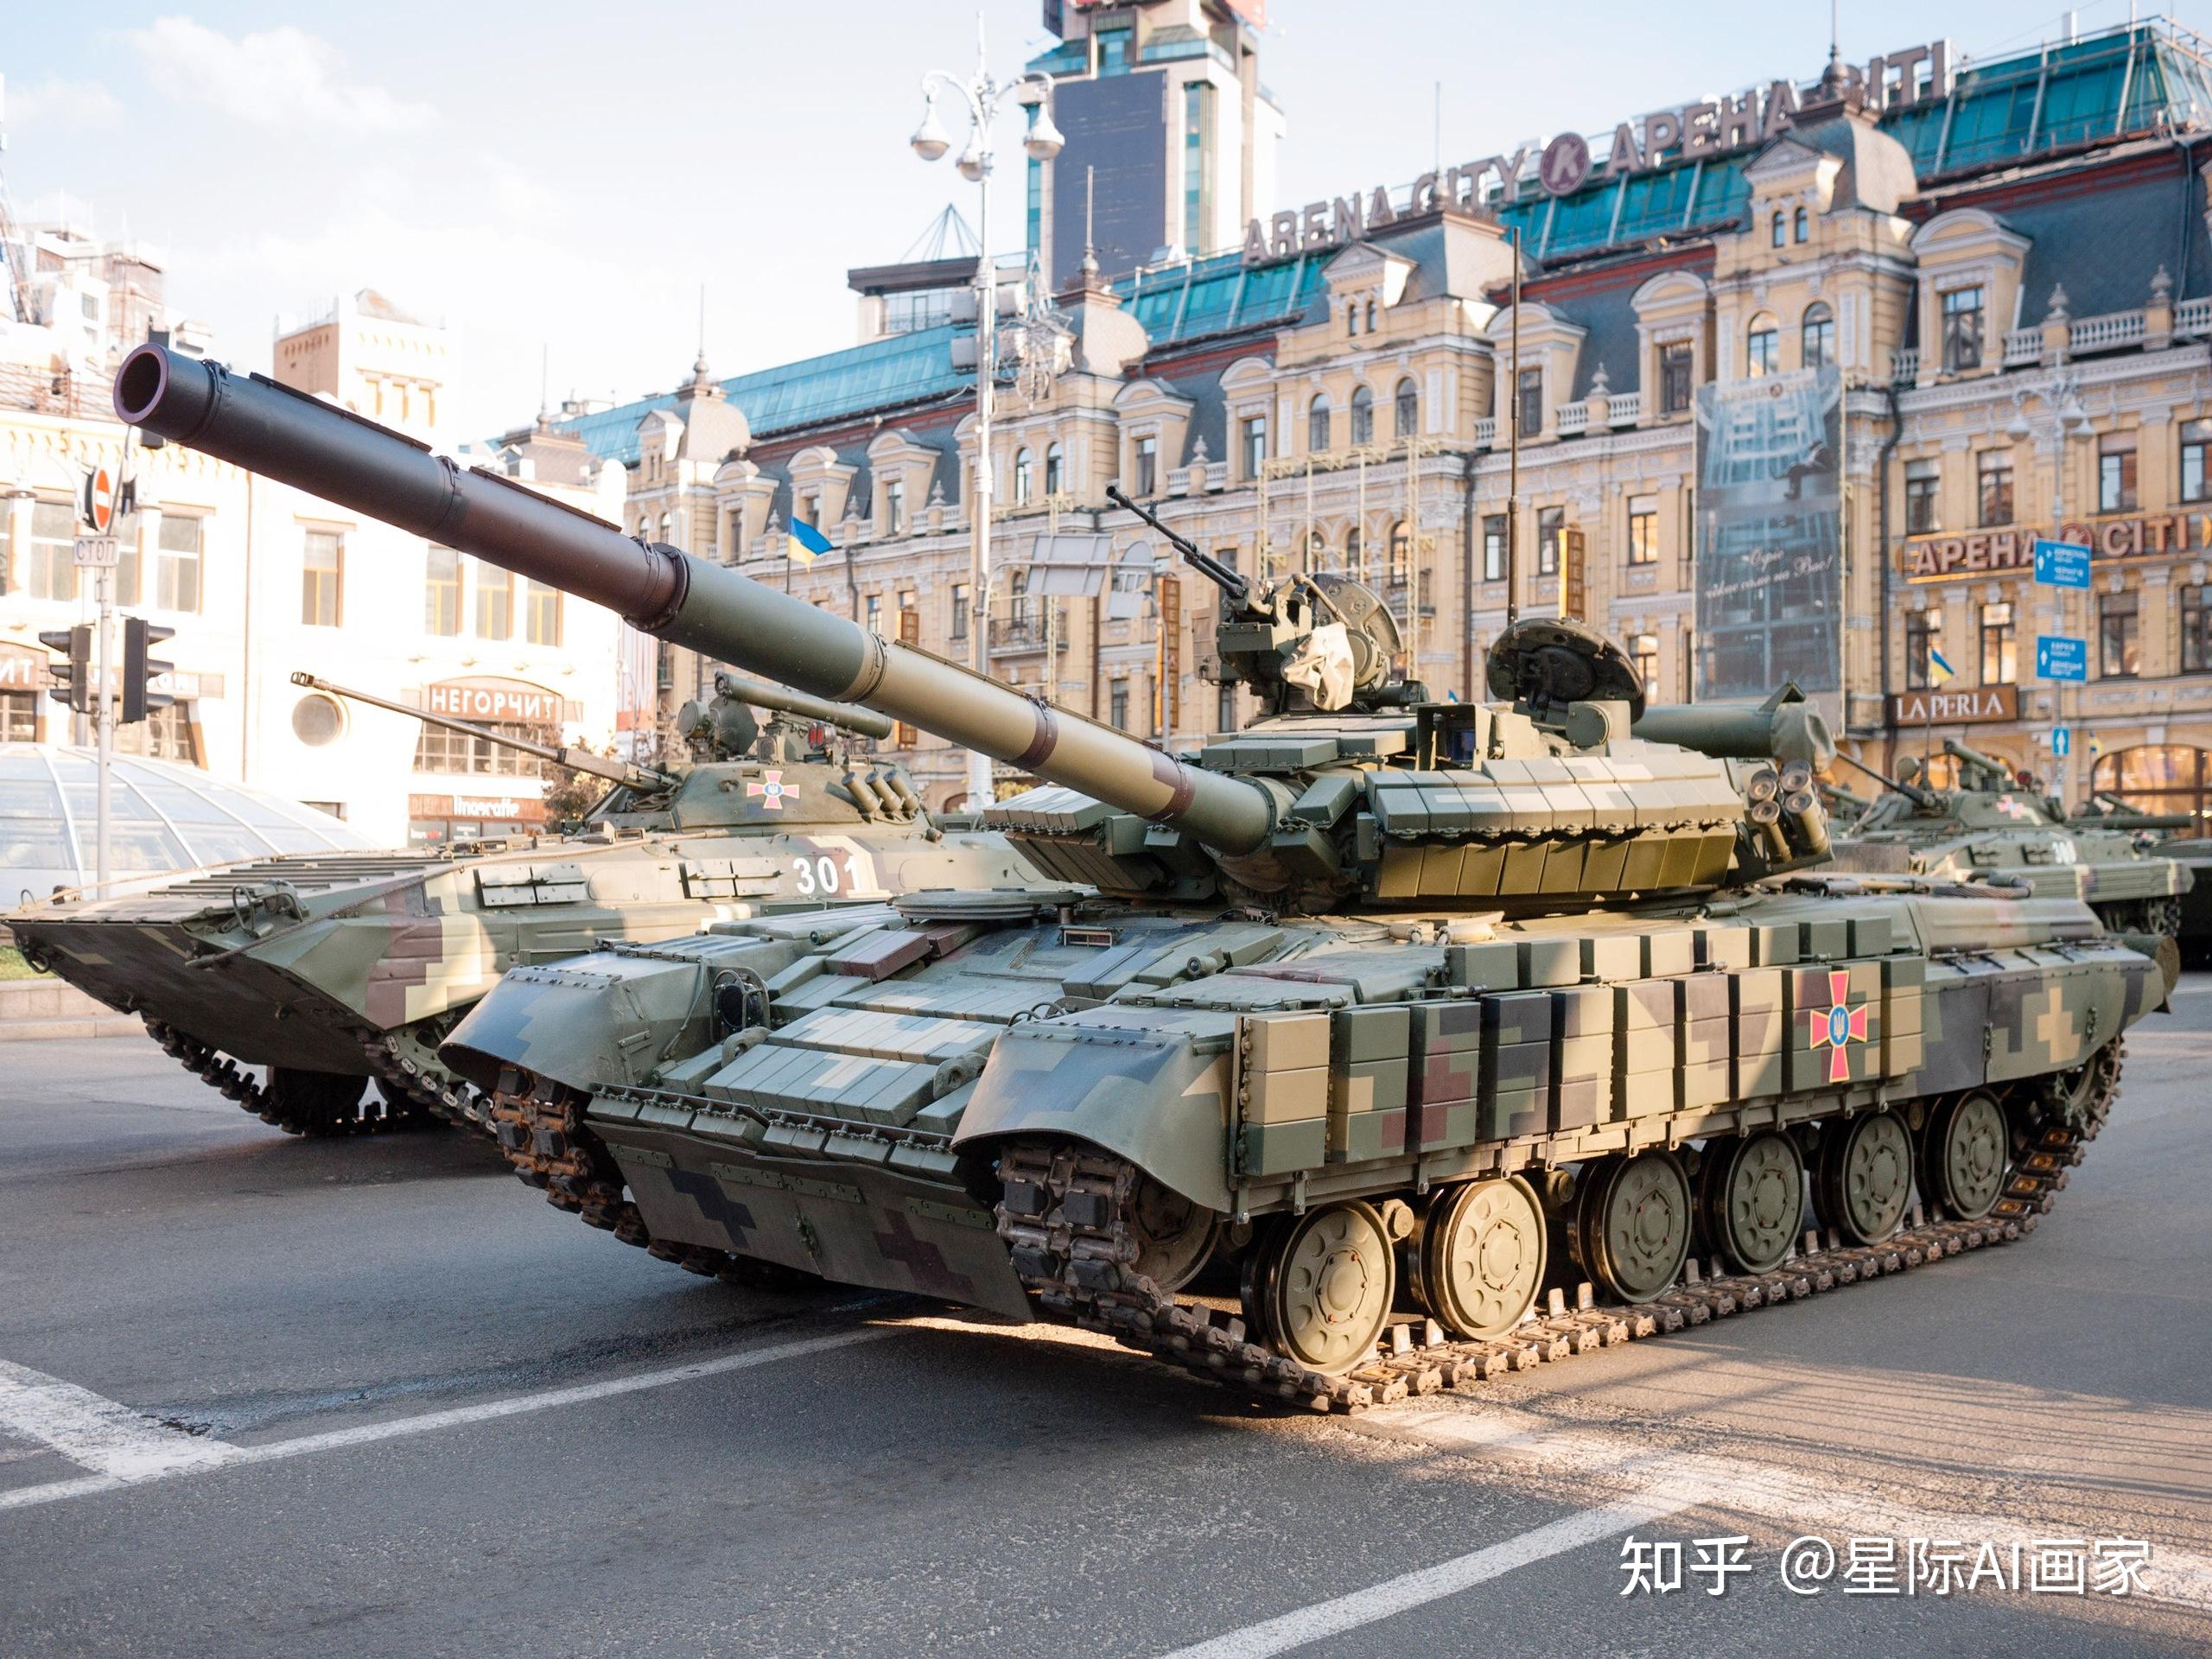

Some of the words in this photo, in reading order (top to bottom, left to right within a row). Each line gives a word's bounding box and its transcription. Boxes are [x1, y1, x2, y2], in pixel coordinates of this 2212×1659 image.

[1605, 79, 1799, 176] АРЕНА
[1241, 185, 1395, 265] ARENA
[1411, 147, 1531, 216] CITY
[76, 540, 115, 562] СТОП
[1914, 531, 2041, 575] АРЕНА
[2101, 515, 2190, 556] СІТІ
[432, 688, 555, 719] НЕГОРЧИТ
[792, 855, 860, 894] 301
